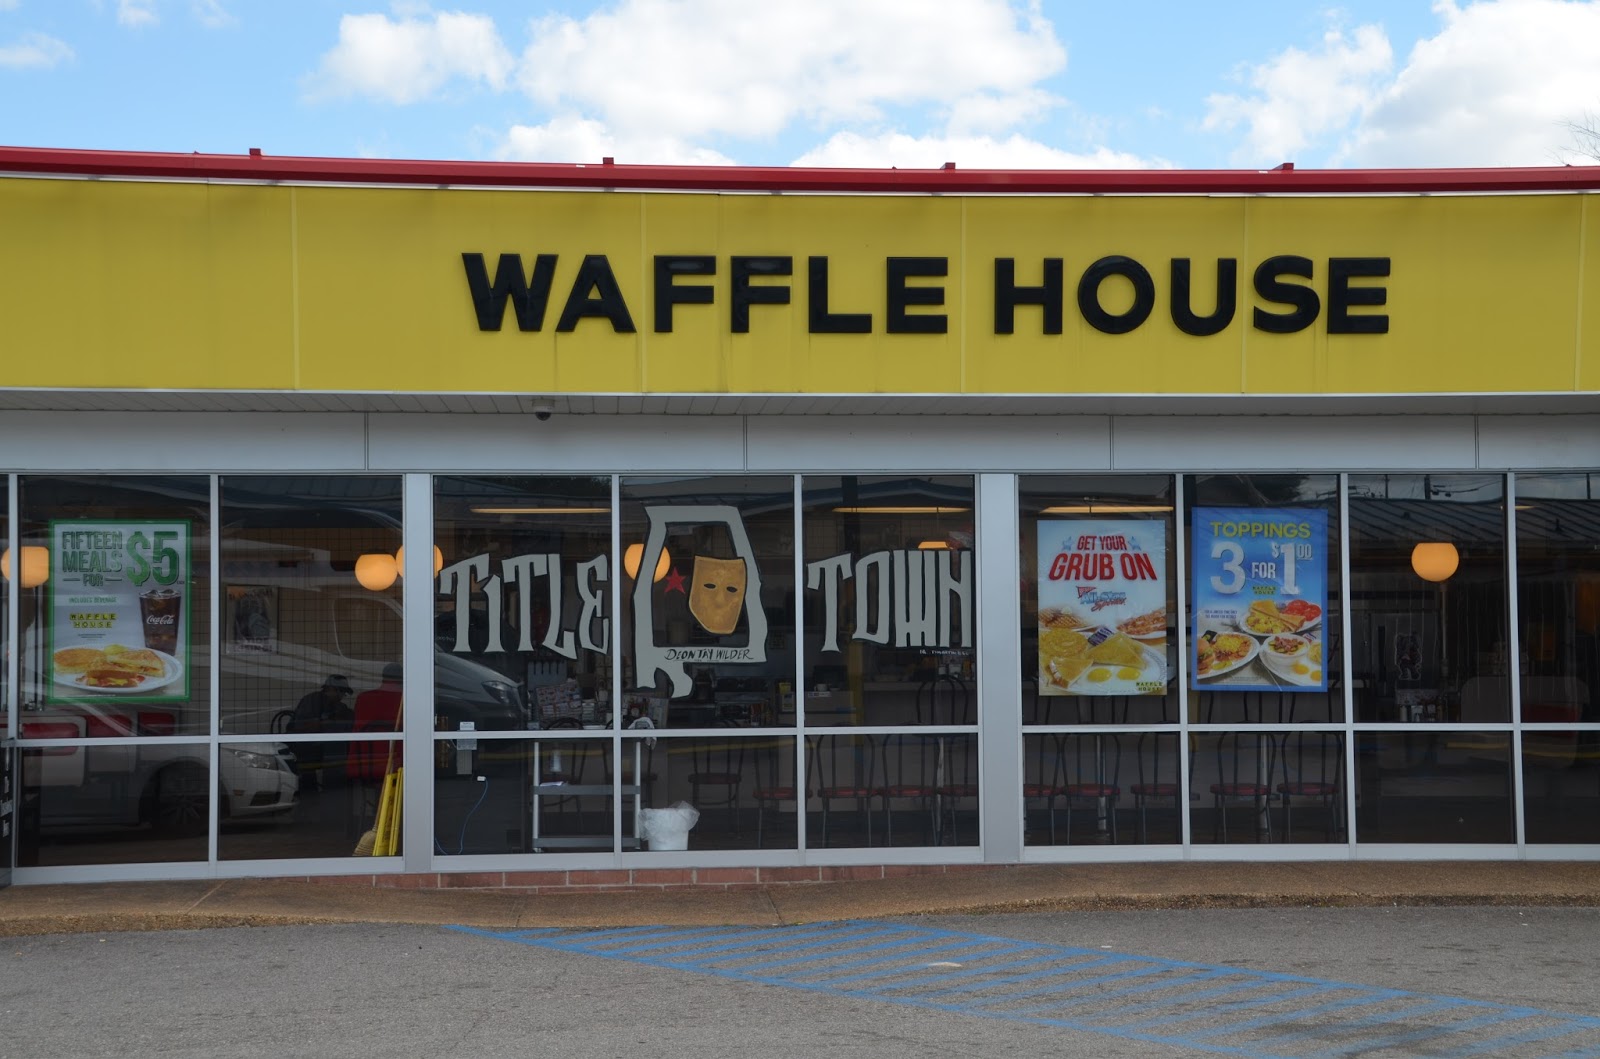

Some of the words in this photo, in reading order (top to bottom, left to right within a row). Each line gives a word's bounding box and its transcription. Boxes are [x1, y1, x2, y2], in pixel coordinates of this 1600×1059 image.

[461, 251, 949, 335] WAFFLE
[993, 254, 1391, 336] HOUSE
[1211, 521, 1312, 539] TOPPINGS
[62, 531, 123, 550] FIFTEEN
[1077, 535, 1098, 551] GET
[1099, 535, 1128, 551] YOUR
[62, 551, 123, 573] MEALS
[126, 531, 180, 587] $5
[1048, 552, 1116, 582] GRUB
[1120, 552, 1158, 581] ON
[1210, 541, 1246, 595] 3
[1251, 561, 1276, 579] FOR
[82, 573, 104, 587] FOR
[439, 551, 610, 661] TITLE
[806, 548, 973, 653] TOWN
[70, 613, 117, 621] WAFFLE
[74, 621, 112, 629] HOUSE
[715, 648, 754, 661] WILDER
